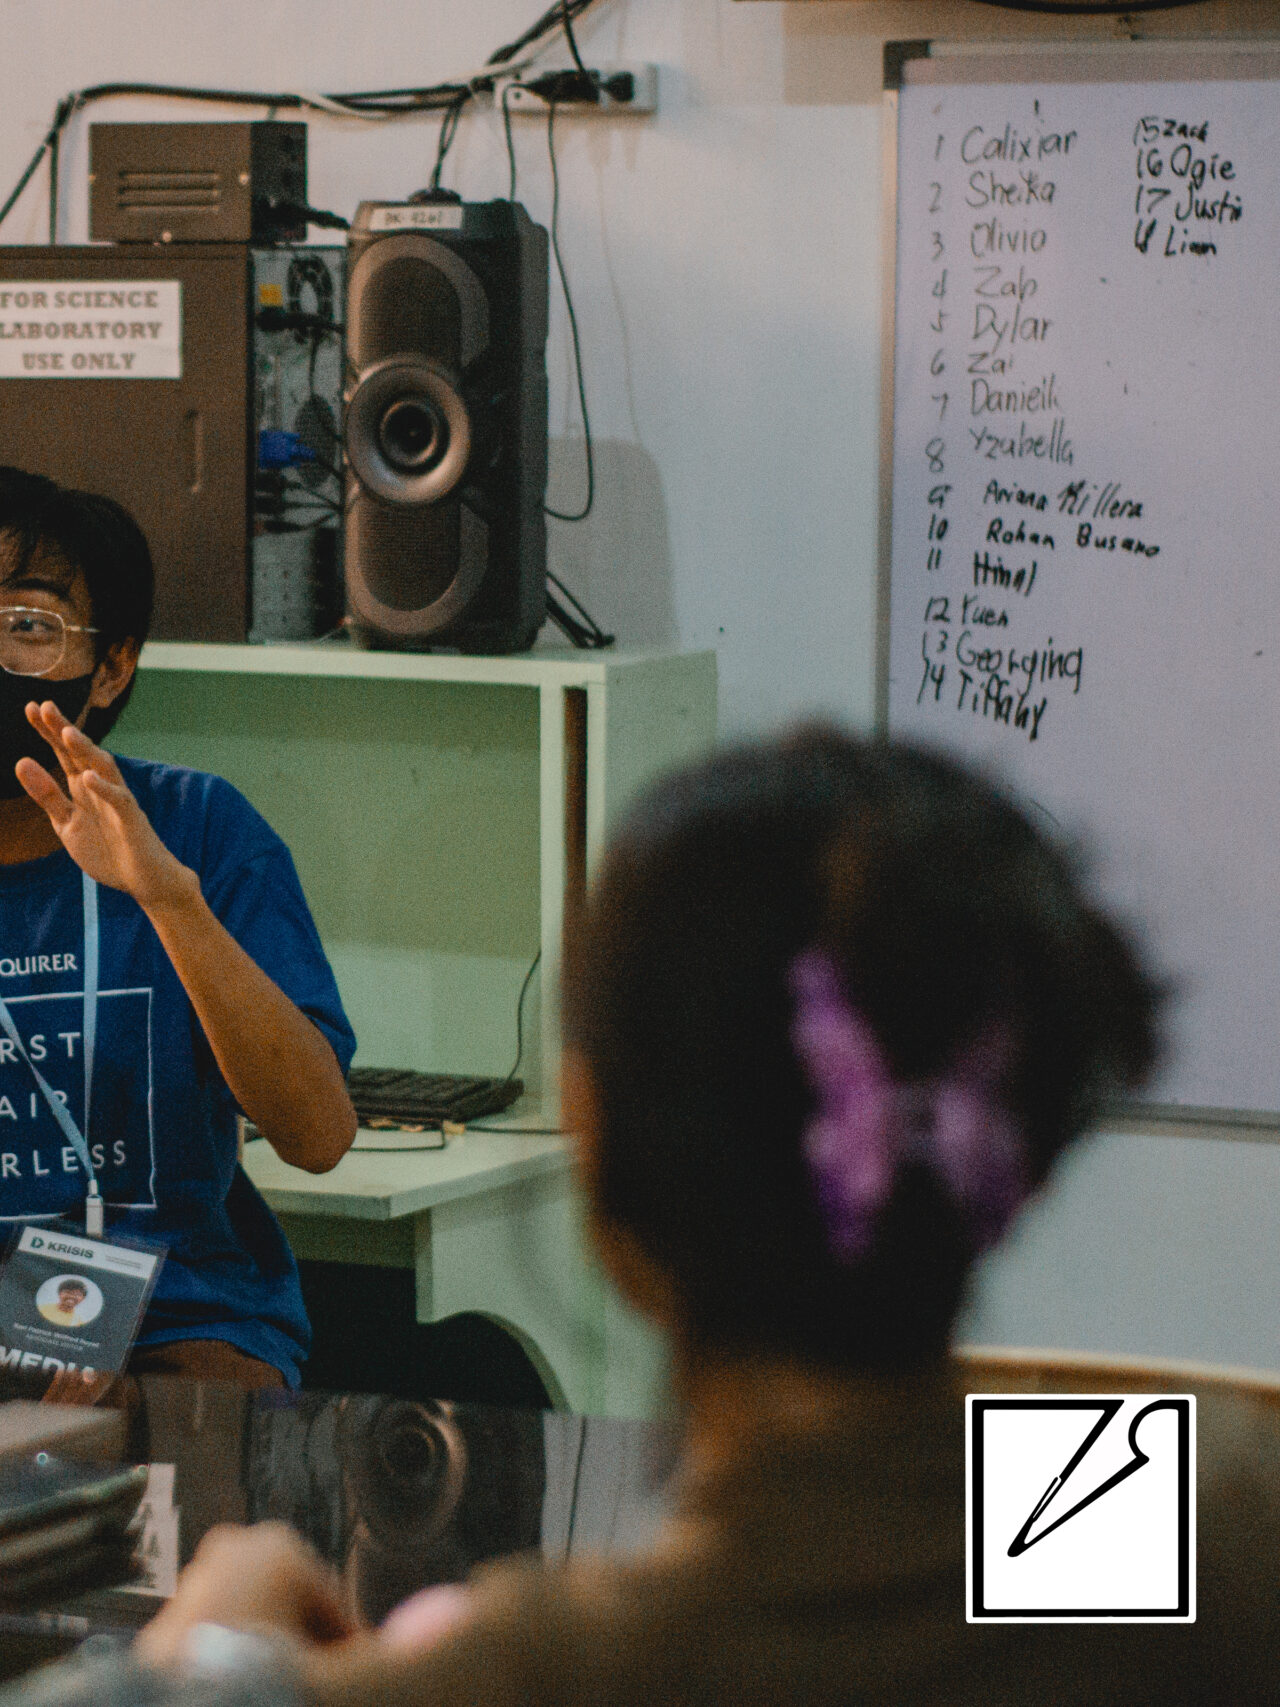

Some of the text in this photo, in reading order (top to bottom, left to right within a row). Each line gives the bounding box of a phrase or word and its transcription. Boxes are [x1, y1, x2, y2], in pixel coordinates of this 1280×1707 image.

[1136, 148, 1164, 180] 16
[928, 180, 942, 214] 2
[1135, 183, 1172, 214] 17
[931, 231, 944, 261] 3
[0, 290, 158, 309] FOR SCIENCE
[22, 352, 136, 371] USE ONLY
[930, 348, 945, 376] 6
[931, 391, 949, 420] 7
[925, 436, 945, 473] 8
[927, 513, 949, 541] 10
[985, 517, 1056, 551] Rohan
[926, 547, 942, 571] 11
[924, 596, 951, 623] 12
[46, 1240, 95, 1259] KRISIS
